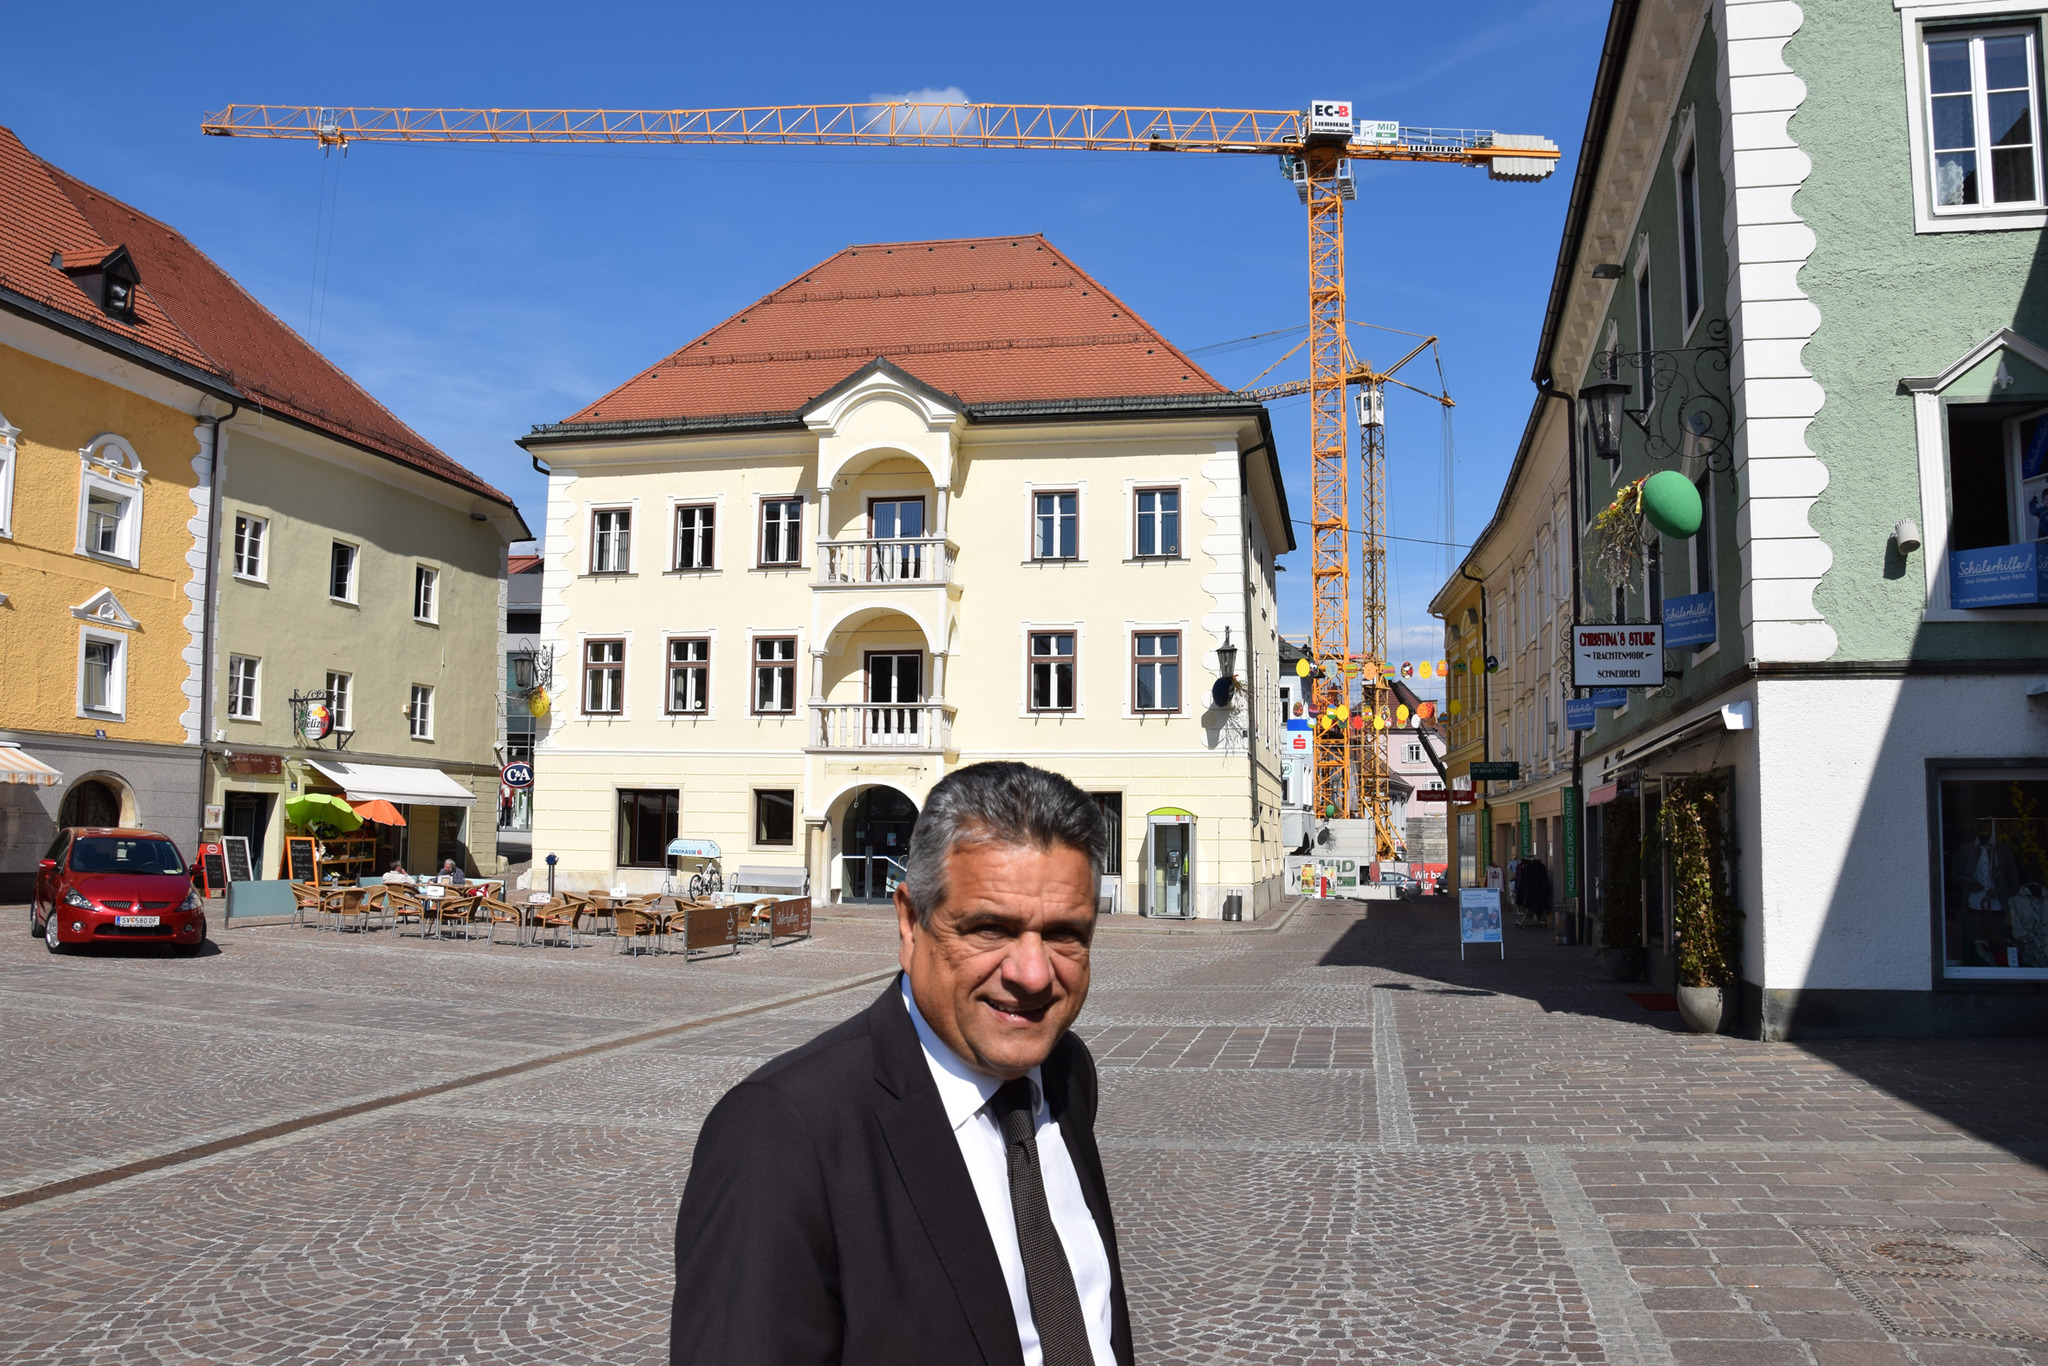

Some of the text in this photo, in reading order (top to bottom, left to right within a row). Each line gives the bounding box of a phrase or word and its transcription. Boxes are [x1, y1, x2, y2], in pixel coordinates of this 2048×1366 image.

[1315, 105, 1349, 117] EC-B
[1959, 592, 2034, 603] www.schuelerhilfe.com
[1579, 632, 1656, 646] CHRISTINA'S STUBE
[1592, 651, 1644, 660] TRACHTENMODE
[1597, 670, 1640, 678] SCHNEIDEREI
[506, 768, 530, 782] C&A
[1568, 846, 1574, 854] OF
